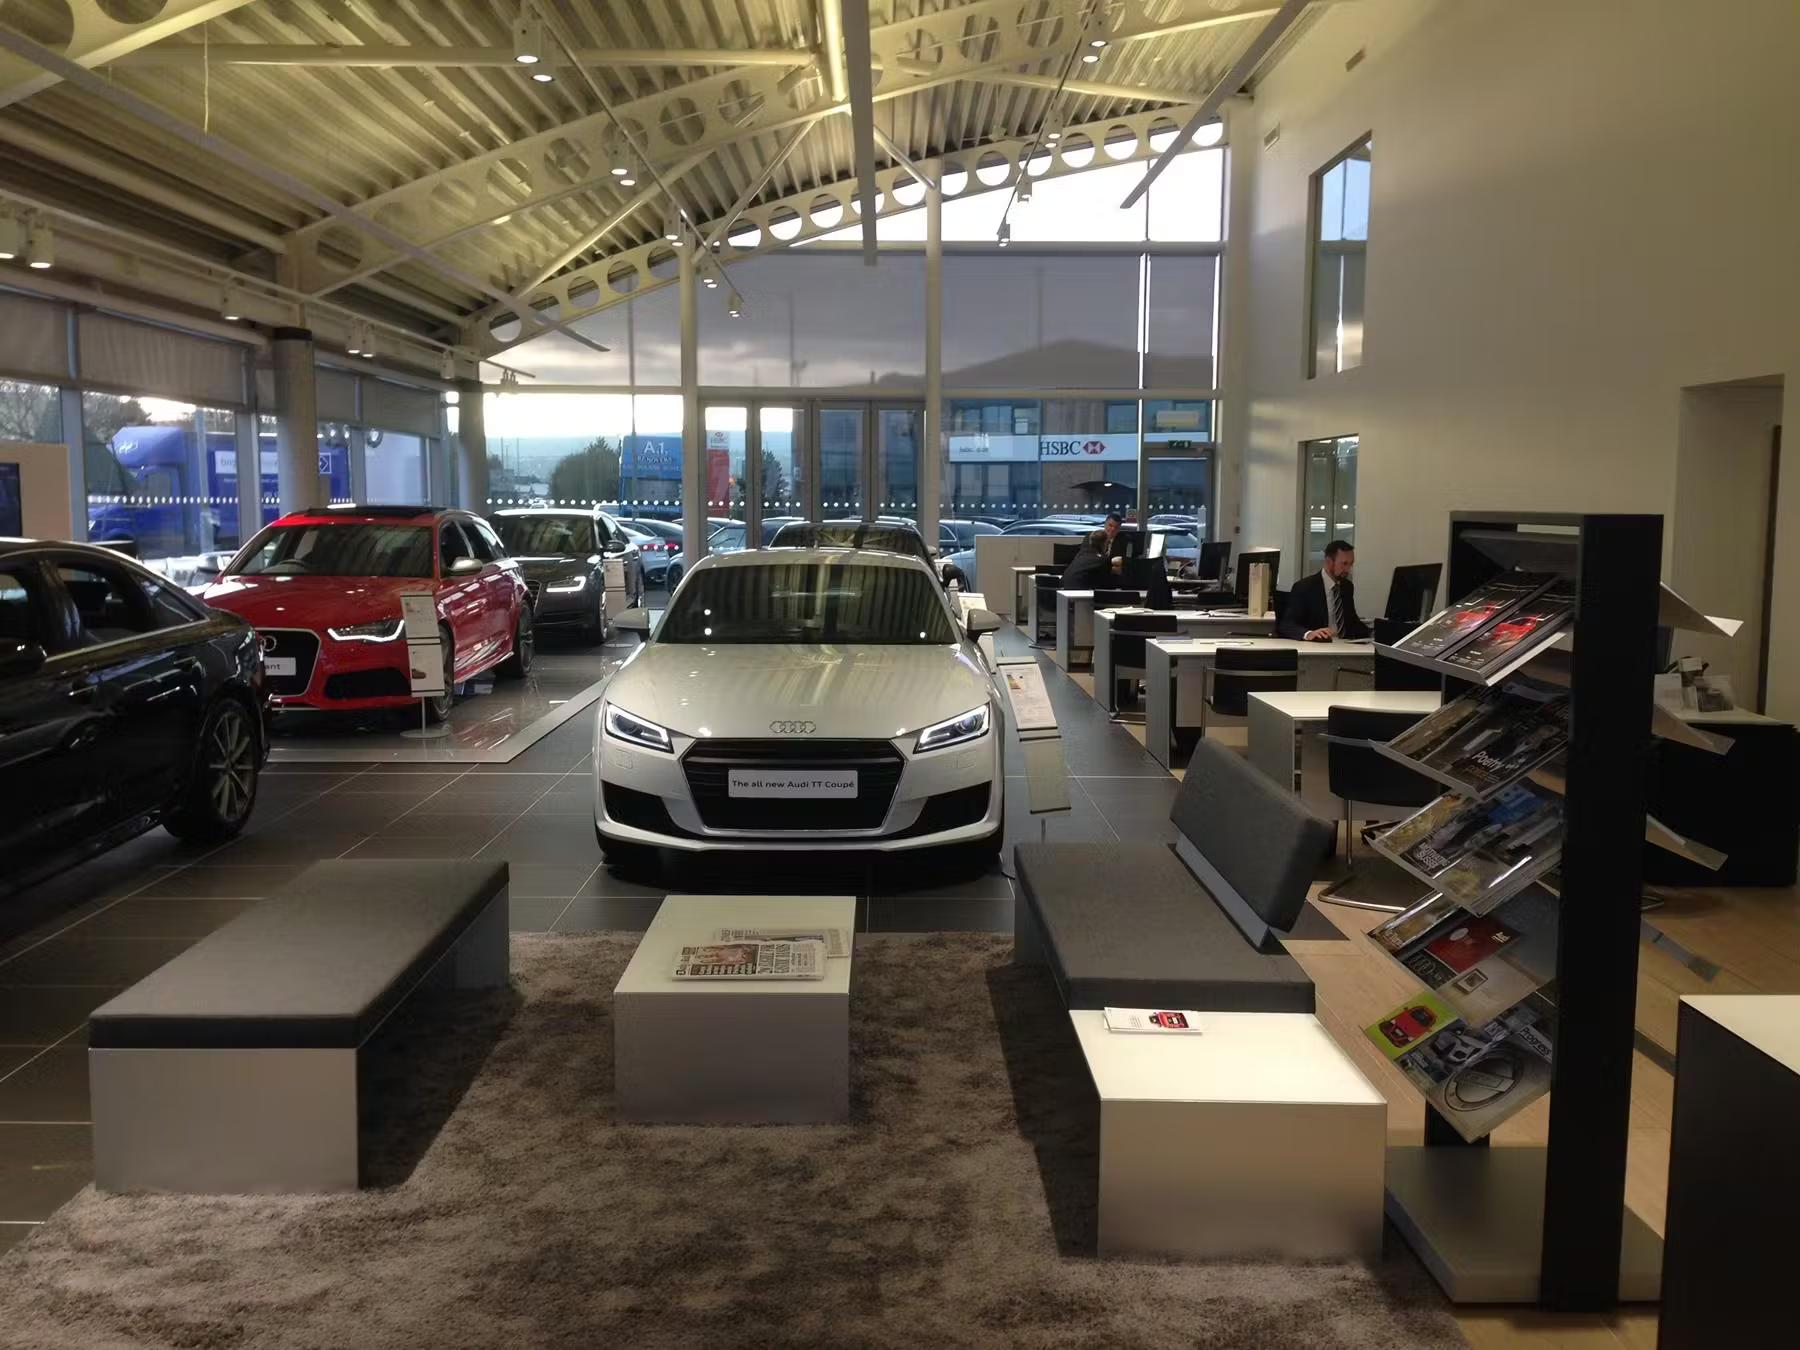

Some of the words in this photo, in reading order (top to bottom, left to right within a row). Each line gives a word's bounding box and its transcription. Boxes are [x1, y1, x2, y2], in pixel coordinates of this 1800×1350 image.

[1040, 440, 1081, 456] HSBC
[732, 780, 749, 788] The
[751, 780, 763, 788] all
[824, 780, 855, 790] Coupé
[1521, 1026, 1552, 1056] Progress
